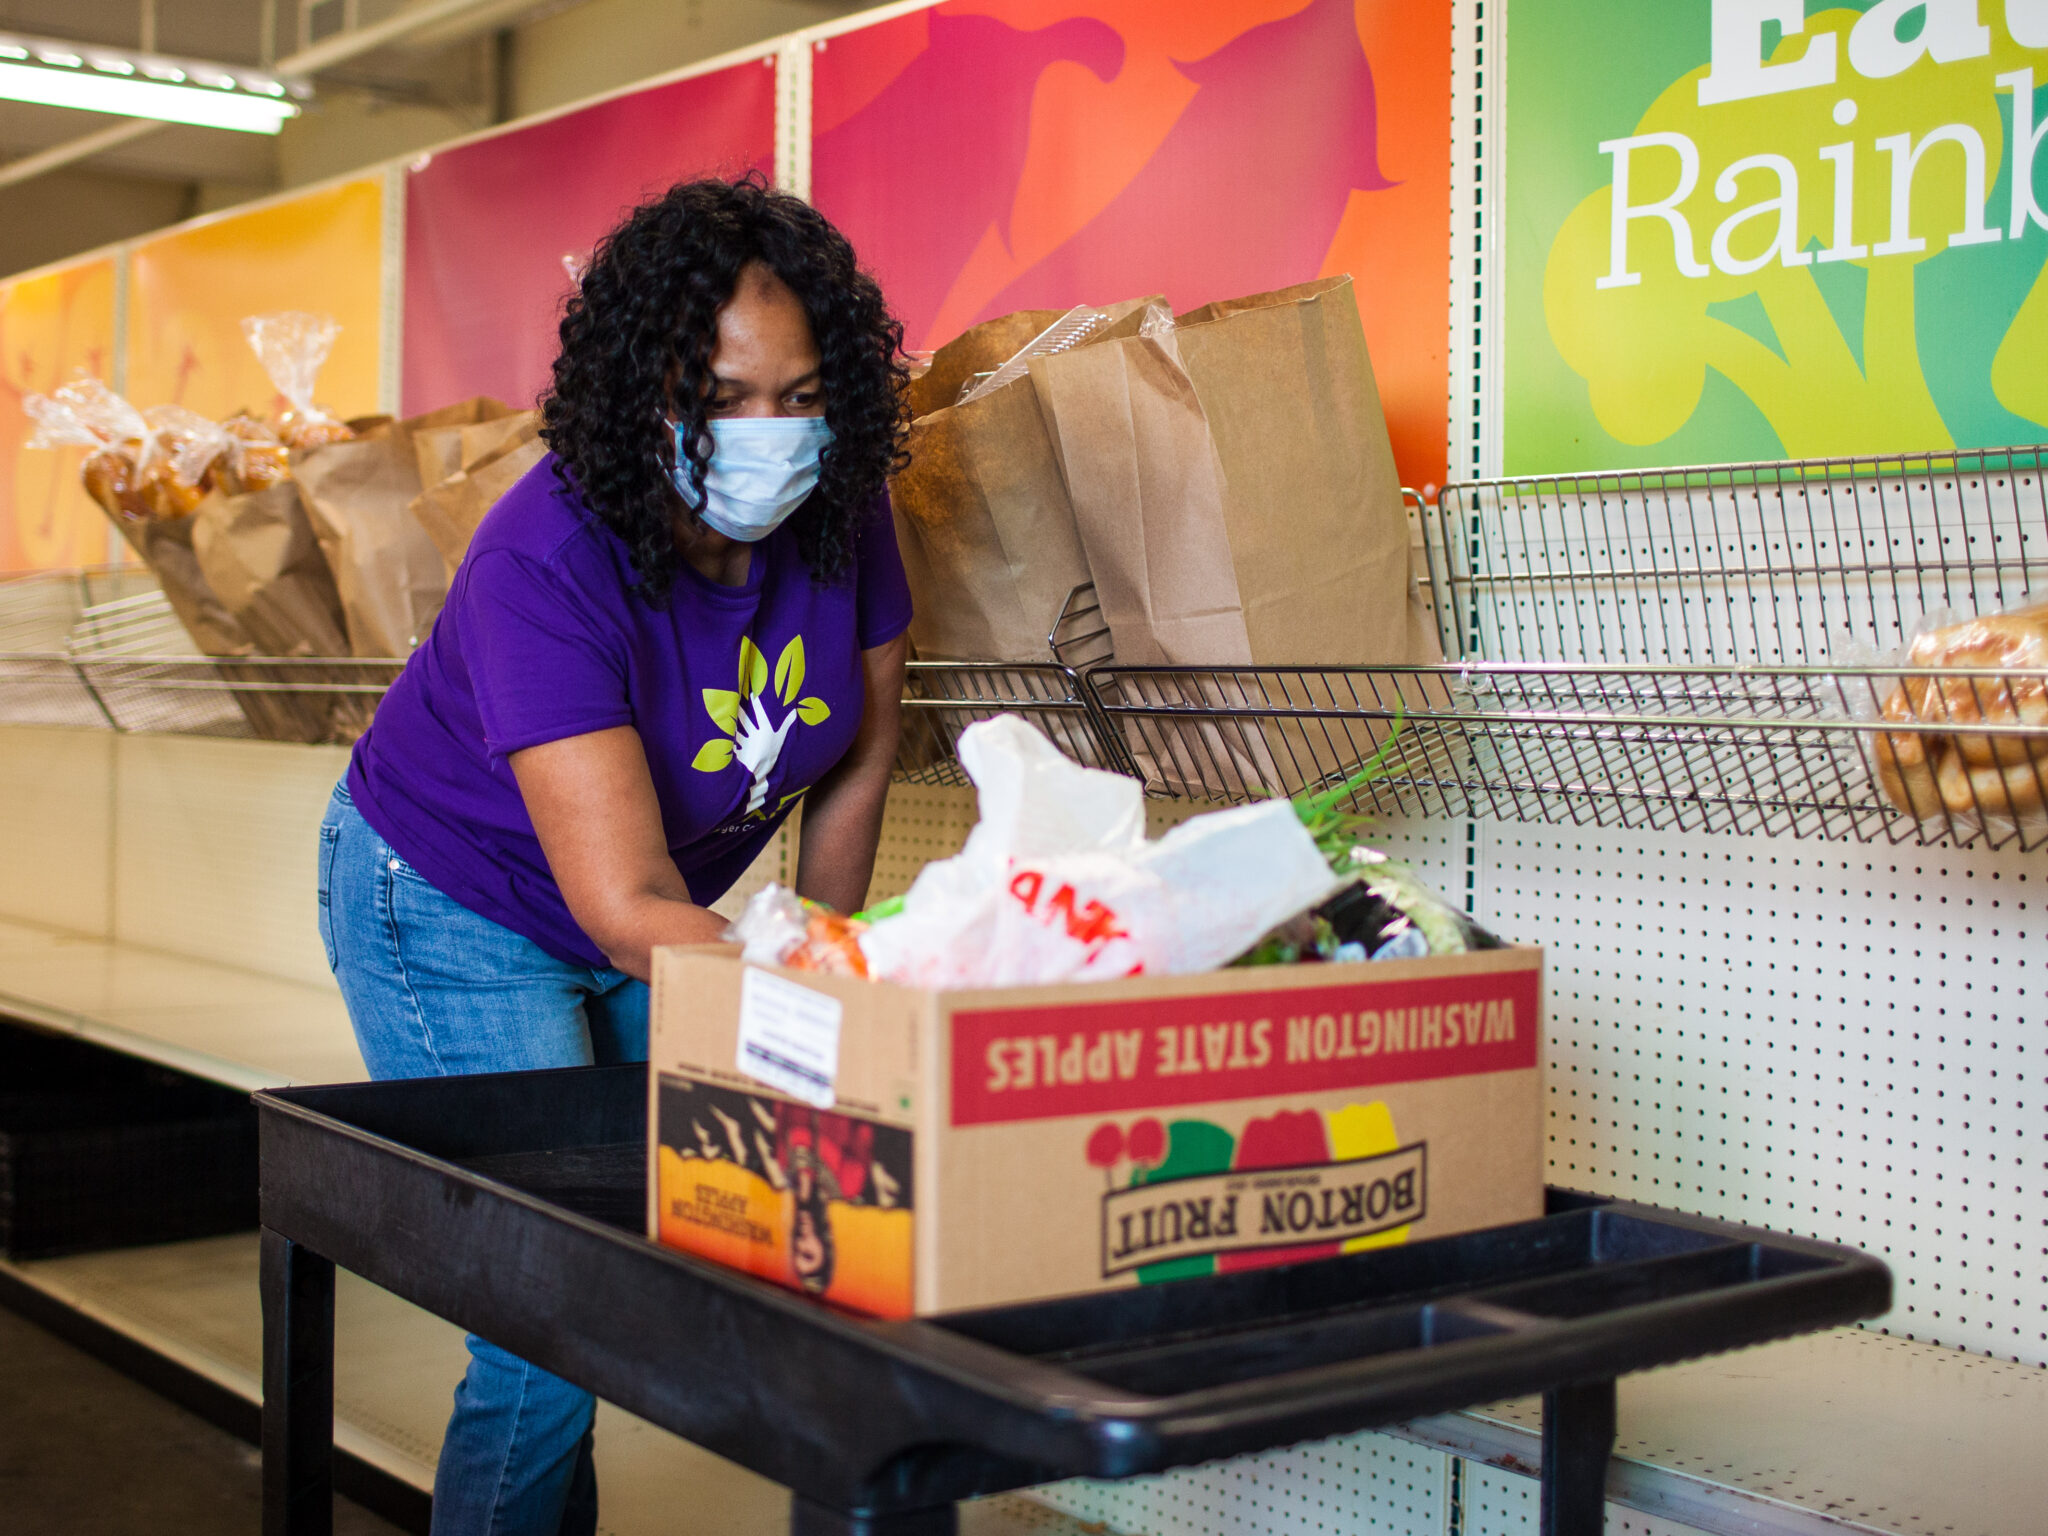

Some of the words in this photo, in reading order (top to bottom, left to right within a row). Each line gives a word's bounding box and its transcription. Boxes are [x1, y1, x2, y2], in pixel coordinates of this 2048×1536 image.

[1698, 0, 2048, 106] Ea
[986, 1029, 1142, 1092] APPLES
[1155, 1019, 1272, 1076] STATE
[1287, 998, 1516, 1064] WASHINGTON
[1114, 1195, 1239, 1259] FRUIT
[1259, 1168, 1417, 1234] BORTON
